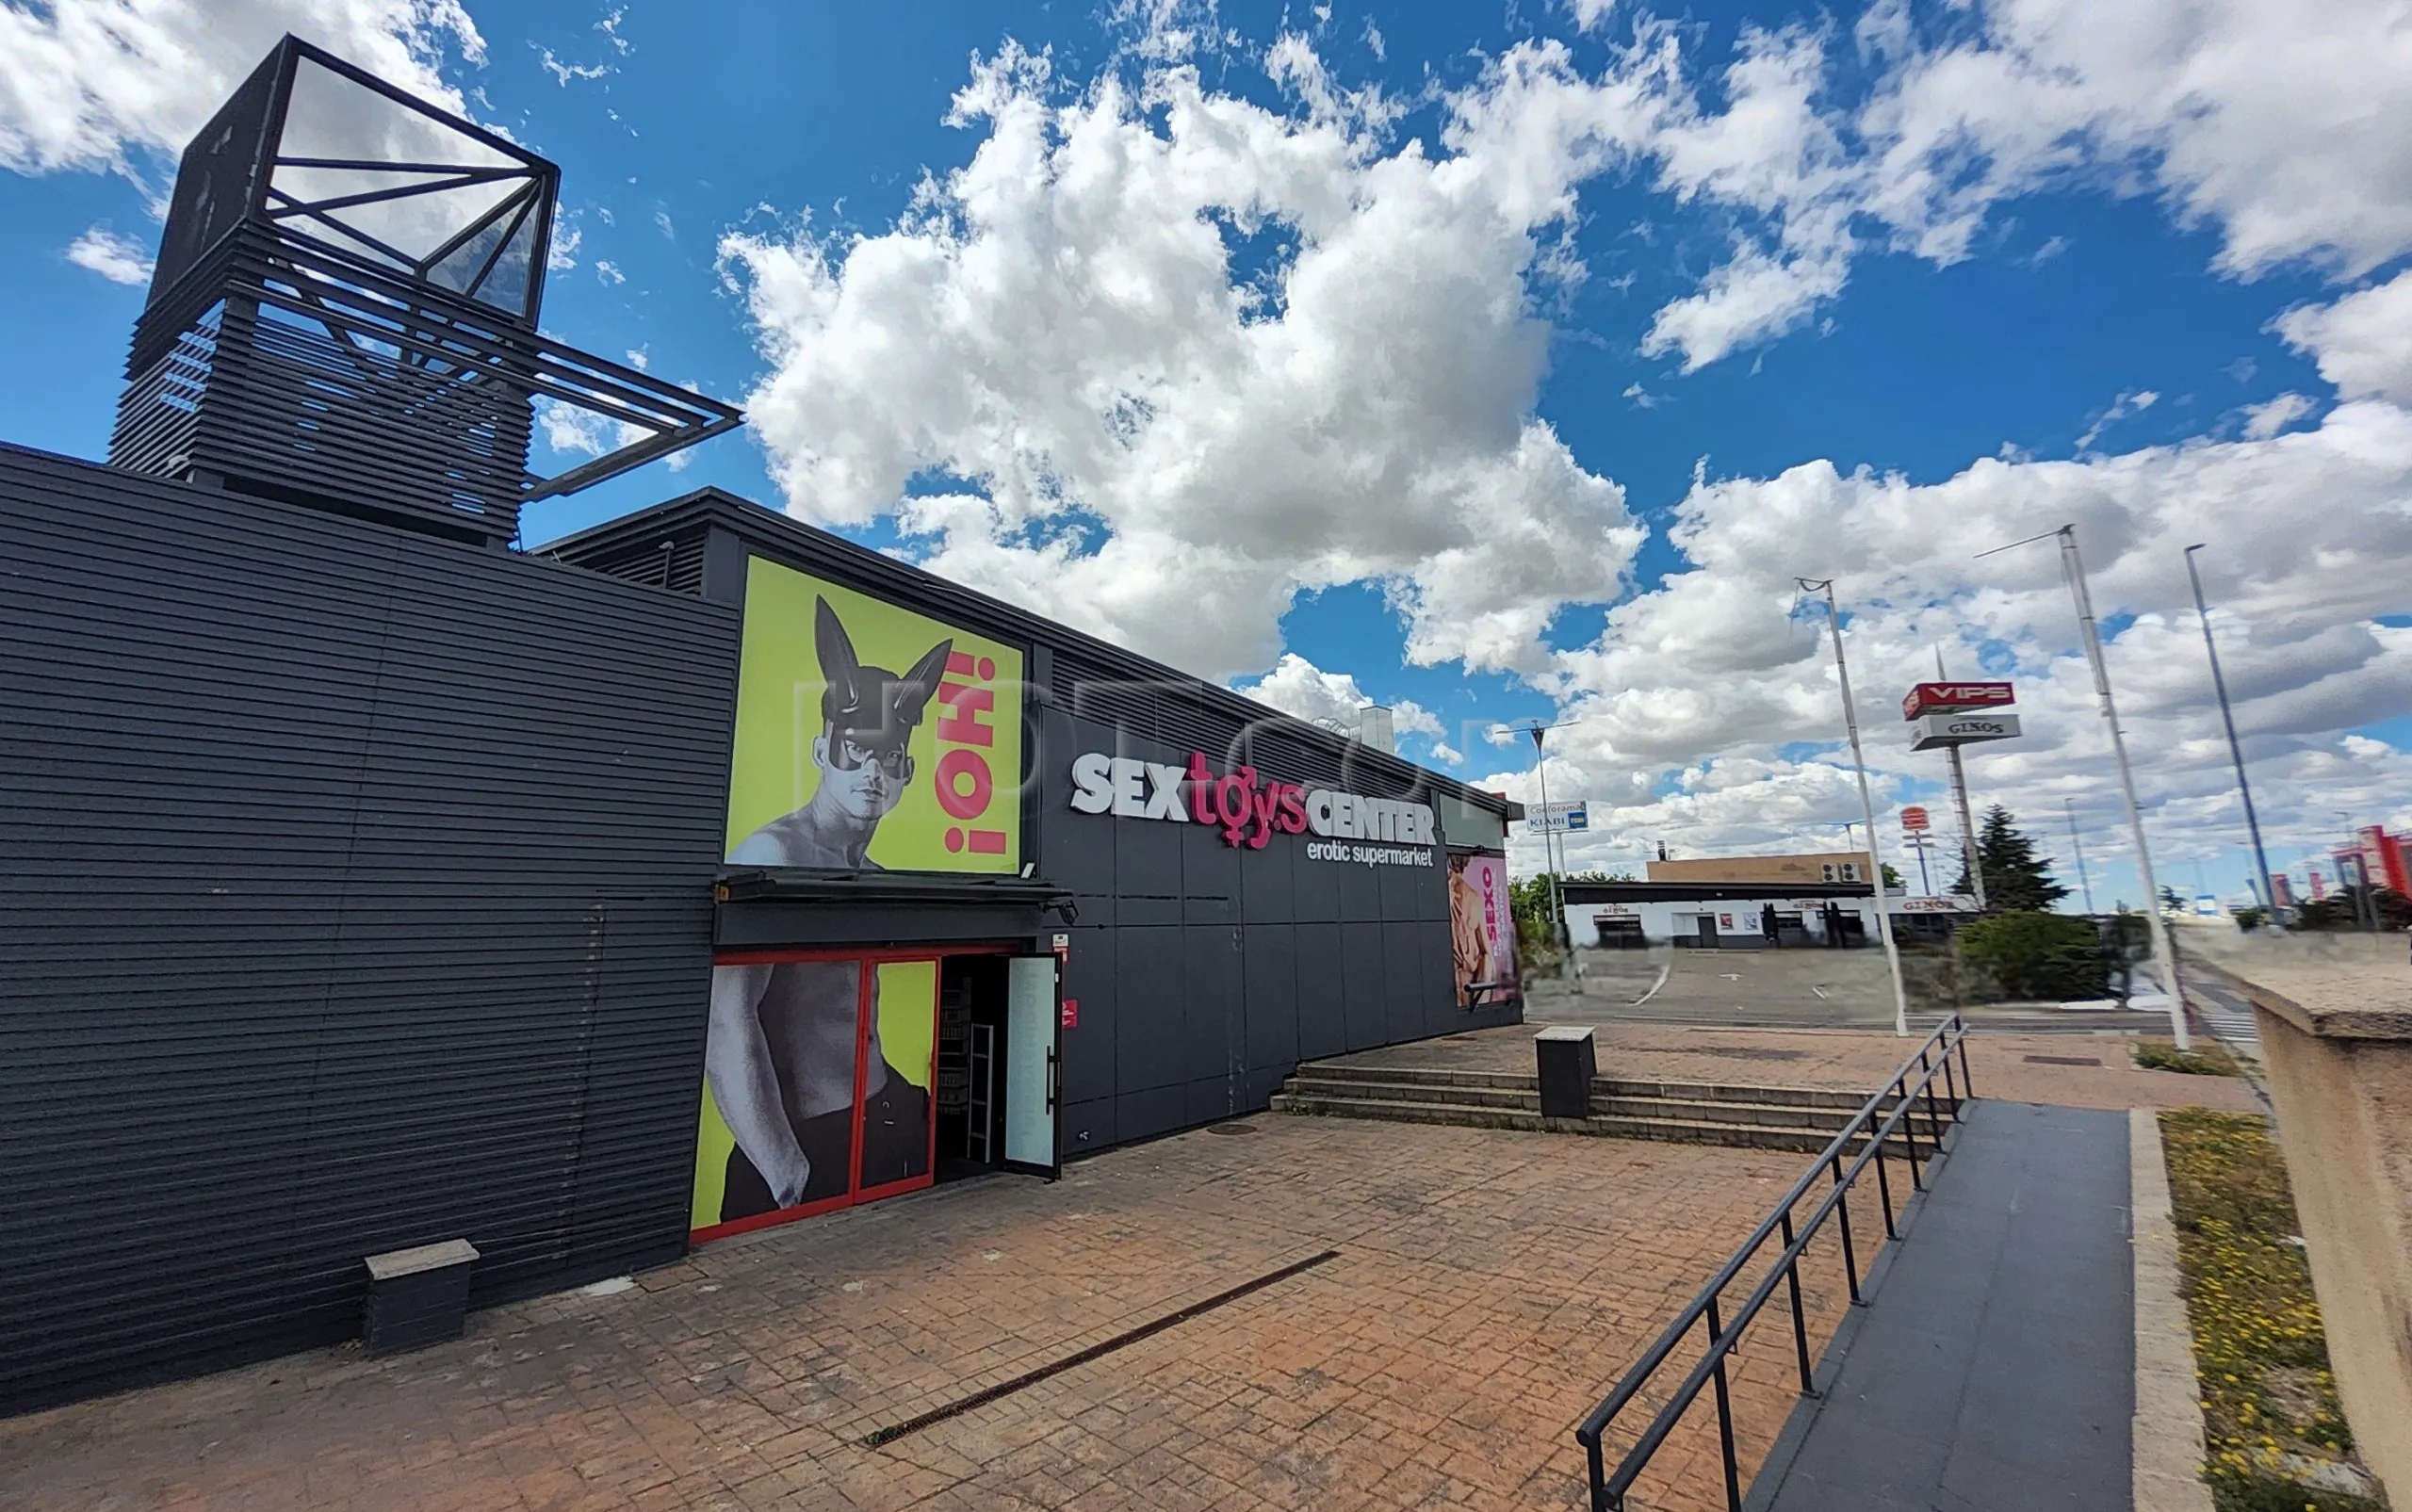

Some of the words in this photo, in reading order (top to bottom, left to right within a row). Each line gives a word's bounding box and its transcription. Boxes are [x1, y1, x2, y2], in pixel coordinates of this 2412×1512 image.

[1928, 686, 2011, 699] VIPS
[1948, 722, 2005, 734] GINOS
[1305, 789, 1437, 846] CENTER
[1529, 817, 1565, 827] KIABI
[1307, 840, 1351, 861] erotic
[1353, 844, 1434, 868] supermarket
[1481, 866, 1498, 942] SEXO
